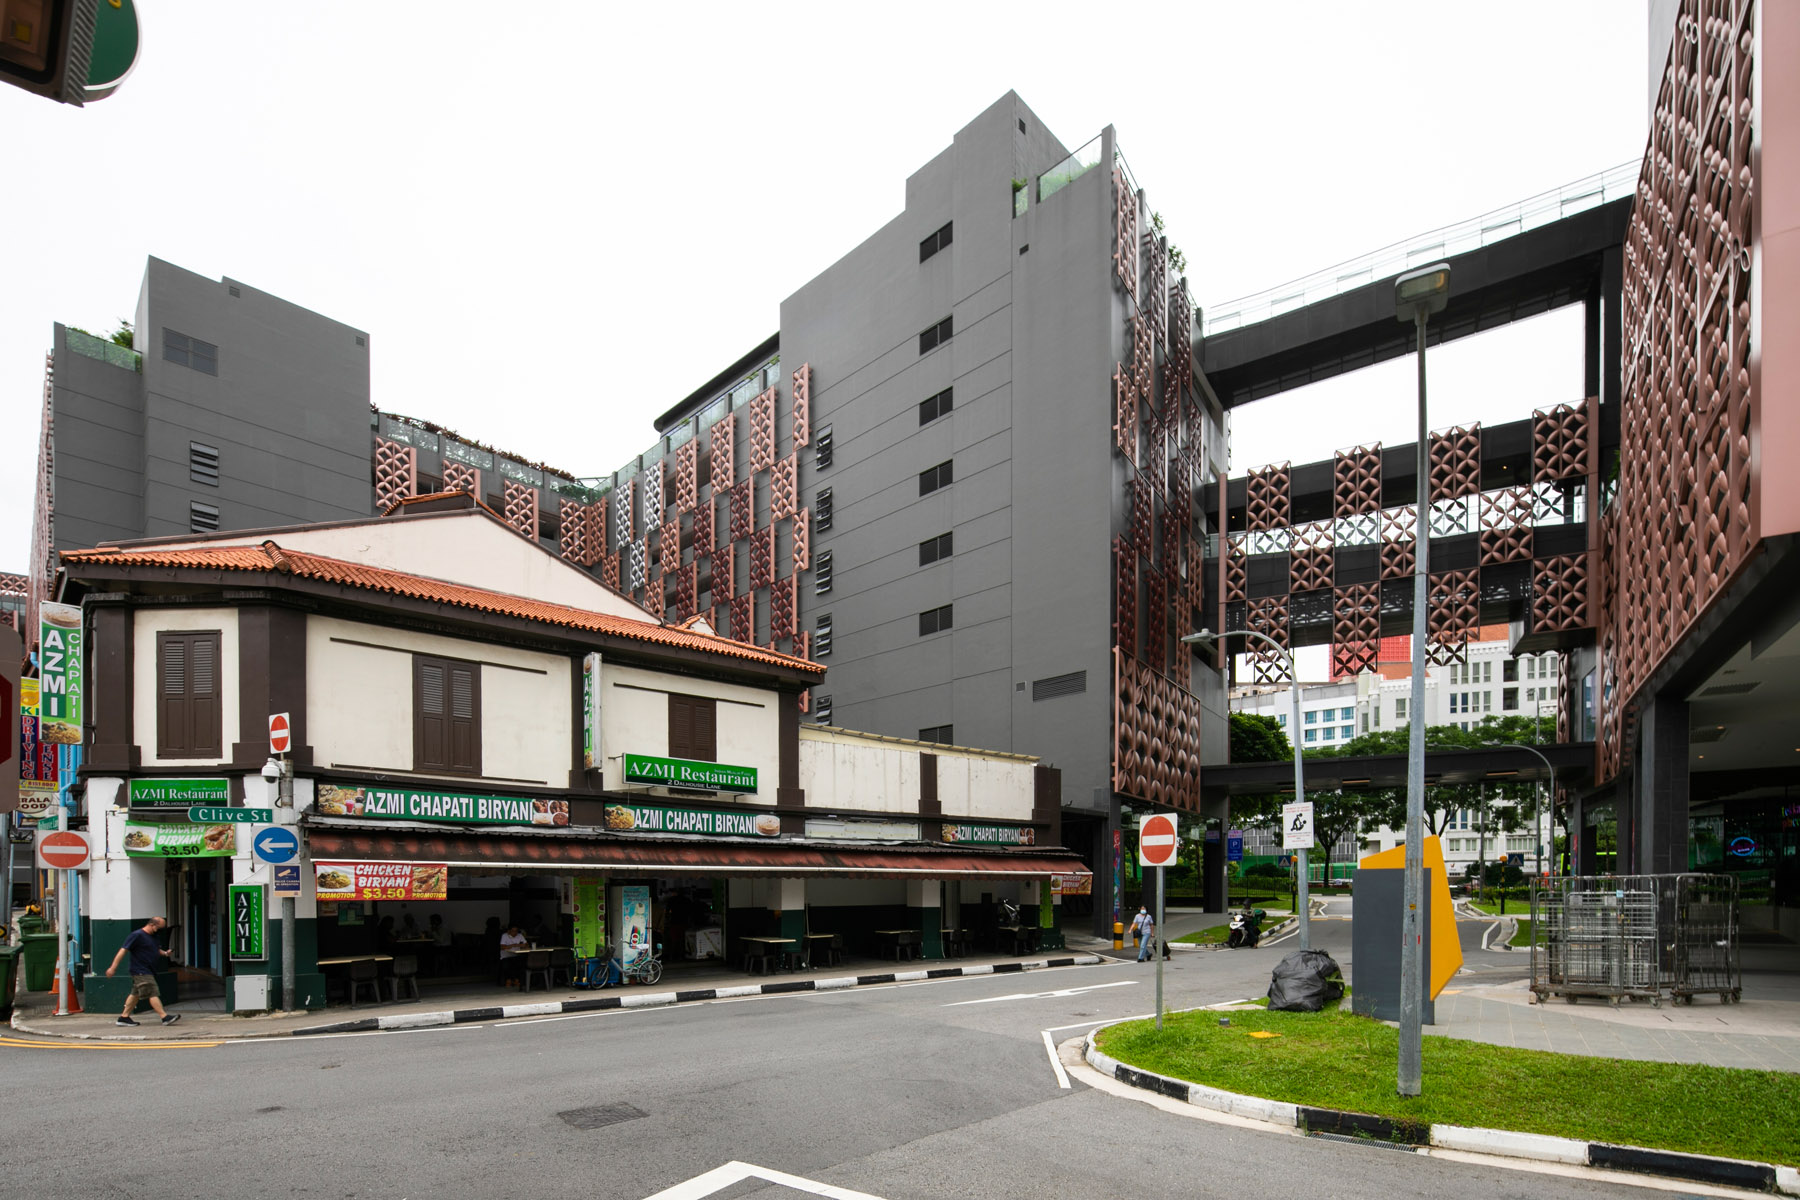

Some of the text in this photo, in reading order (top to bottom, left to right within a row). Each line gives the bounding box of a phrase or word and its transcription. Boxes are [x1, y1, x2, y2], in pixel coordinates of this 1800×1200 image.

[43, 629, 66, 717] AZMI
[68, 633, 81, 718] CHAPATI
[22, 716, 35, 779] DRIVING
[42, 743, 54, 780] ENSE
[629, 761, 755, 786] AZMI Restaurant
[674, 780, 705, 788] DALHOUSIE
[133, 788, 227, 799] AZMI Restaurant
[365, 791, 533, 822] AZMI CHAPATI BIRYANI
[198, 809, 268, 821] Clive St
[634, 808, 756, 834] AZMI CHAPATI BIRYANI
[158, 824, 206, 834] CHICKEN
[957, 825, 972, 841] AZMI
[973, 826, 997, 842] CHAPATI
[157, 834, 203, 846] BIRYANI
[161, 845, 200, 856] $3.50
[355, 864, 412, 876] CHICKEN
[358, 876, 410, 888] BIRYANI
[362, 888, 406, 899] $3.50
[236, 893, 250, 952] AZMI
